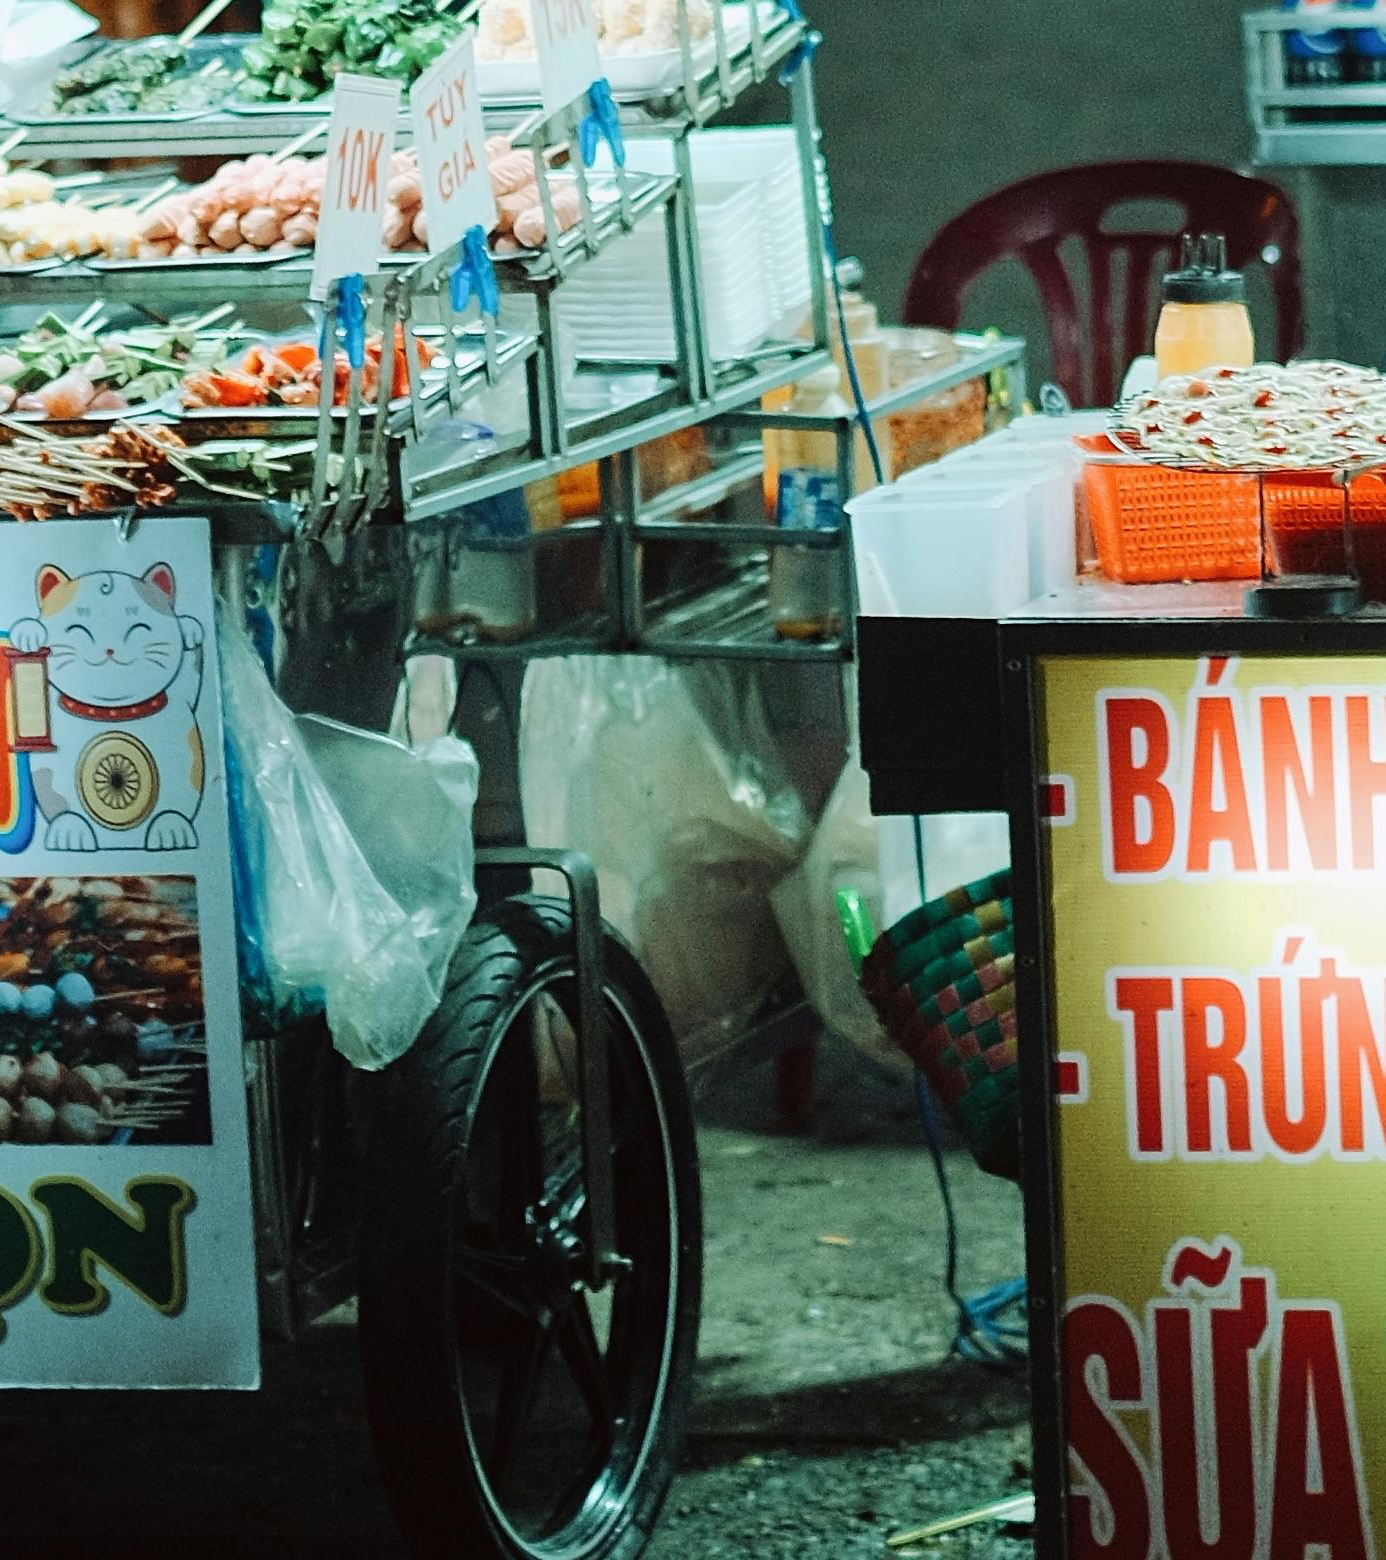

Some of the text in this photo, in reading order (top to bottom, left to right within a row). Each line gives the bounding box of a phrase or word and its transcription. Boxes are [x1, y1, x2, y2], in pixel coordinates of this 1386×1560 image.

[424, 69, 470, 144] TÙY
[337, 125, 385, 214] 10K
[437, 138, 478, 205] GIÁ
